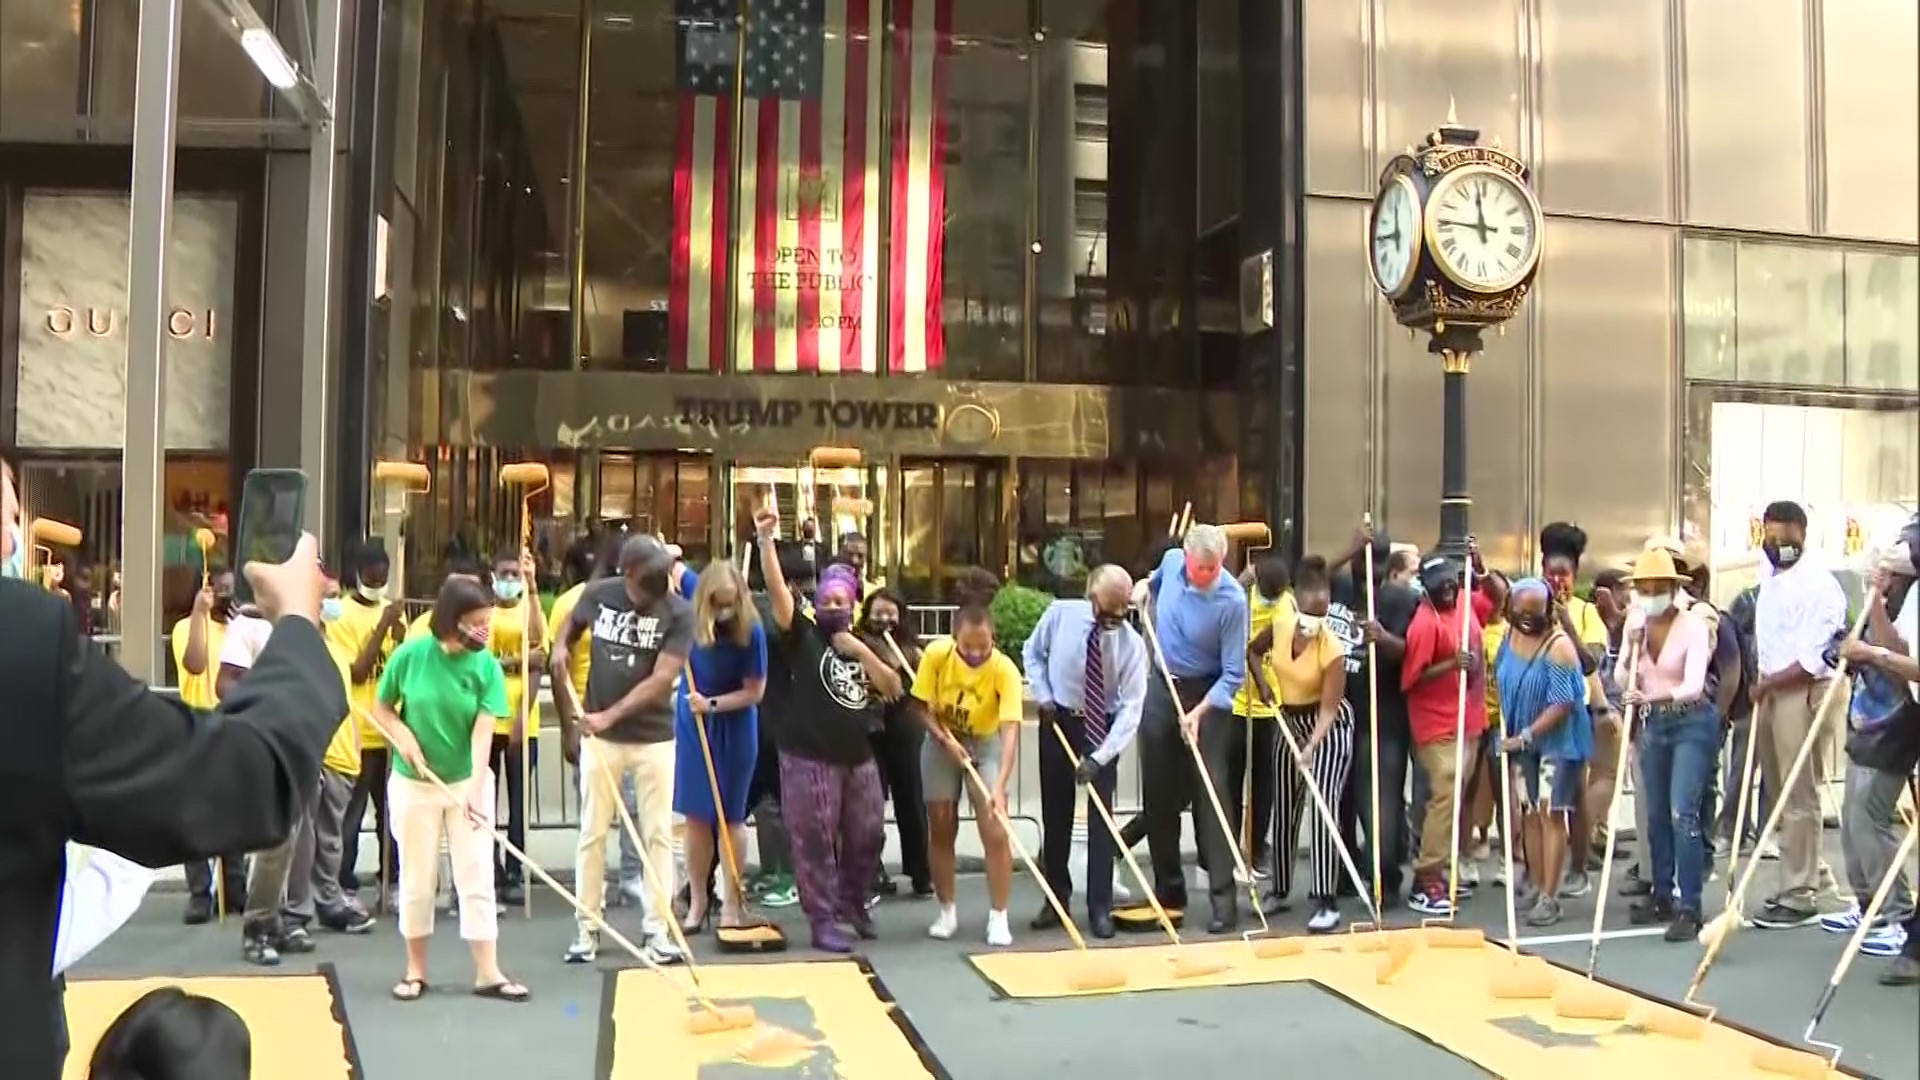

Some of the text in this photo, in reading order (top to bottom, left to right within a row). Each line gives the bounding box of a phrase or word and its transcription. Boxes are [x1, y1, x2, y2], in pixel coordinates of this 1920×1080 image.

[747, 271, 791, 290] THE
[47, 307, 213, 338] GUCI
[676, 396, 938, 430] TRUMP TOWER
